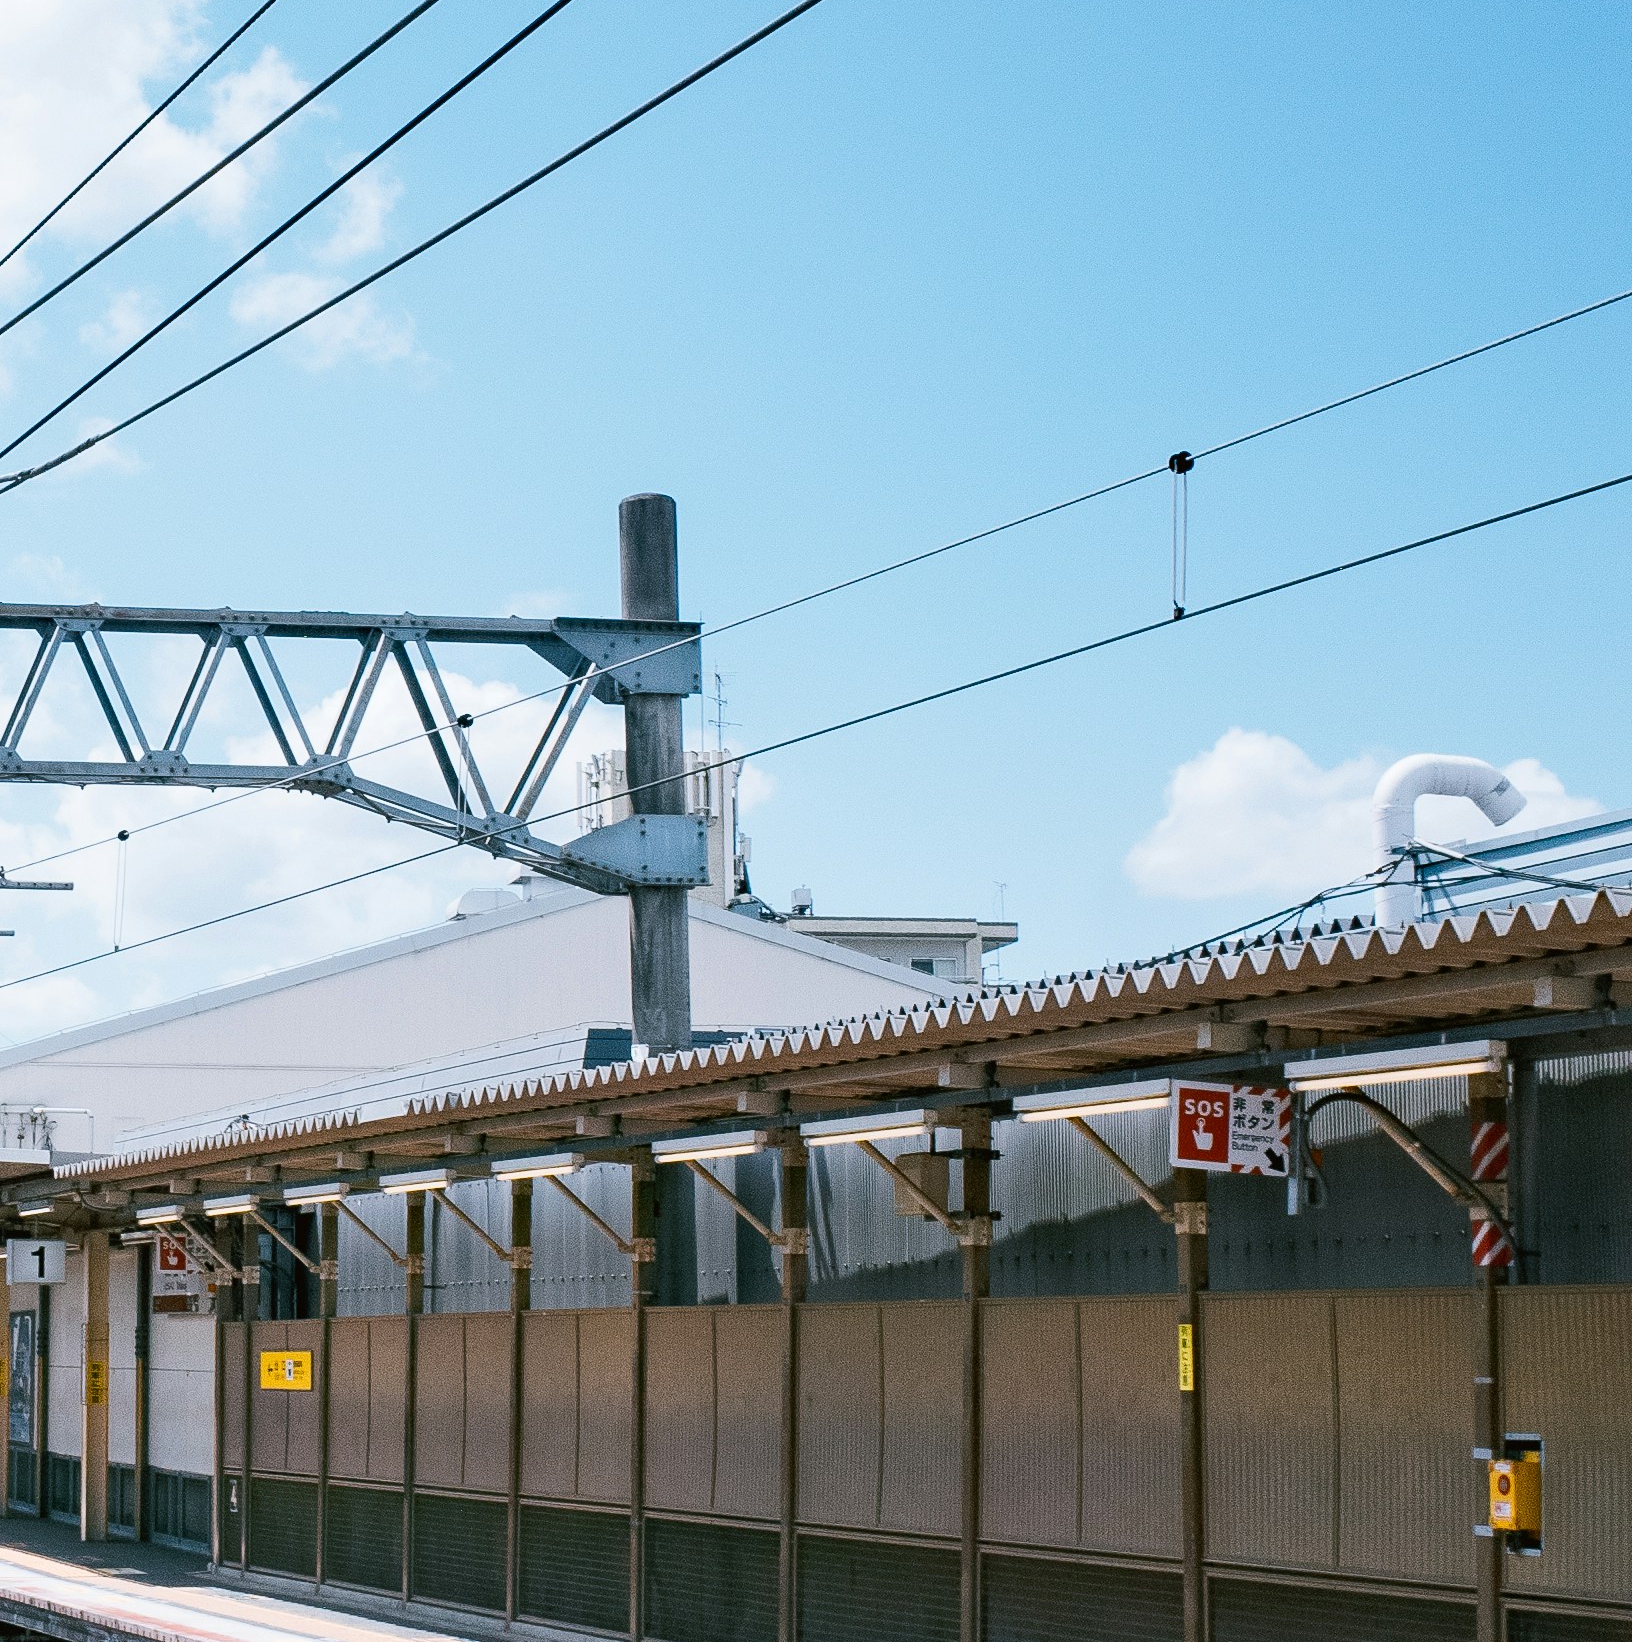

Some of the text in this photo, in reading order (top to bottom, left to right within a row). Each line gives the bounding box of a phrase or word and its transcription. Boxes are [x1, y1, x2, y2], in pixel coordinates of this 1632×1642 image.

[1184, 1098, 1224, 1118] SOS
[1233, 1097, 1275, 1114] 非常
[1233, 1115, 1275, 1130] ボタン
[1232, 1130, 1275, 1144] Emergency
[1232, 1141, 1258, 1151] Button
[162, 1241, 184, 1250] SO
[31, 1246, 45, 1278] 1
